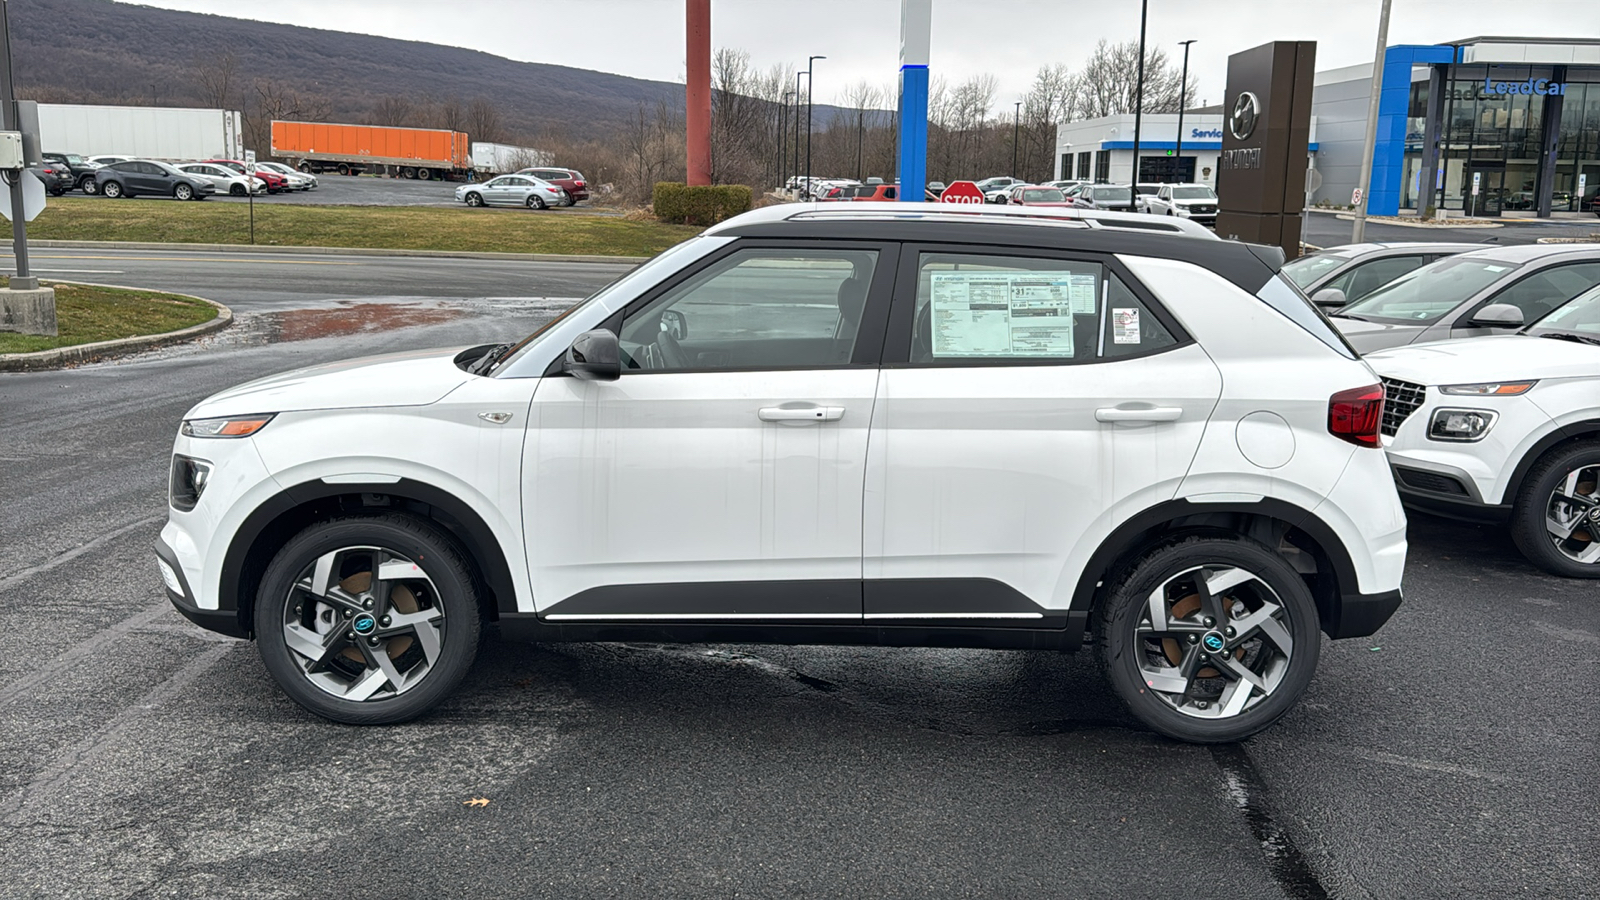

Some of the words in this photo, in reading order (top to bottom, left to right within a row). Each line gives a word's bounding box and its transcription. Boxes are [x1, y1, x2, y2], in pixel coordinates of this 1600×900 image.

[1484, 77, 1568, 96] LeadCar
[1191, 128, 1223, 138] Servic
[1222, 147, 1261, 170] HYUNDAI
[247, 163, 255, 173] 40
[944, 195, 981, 204] STOP
